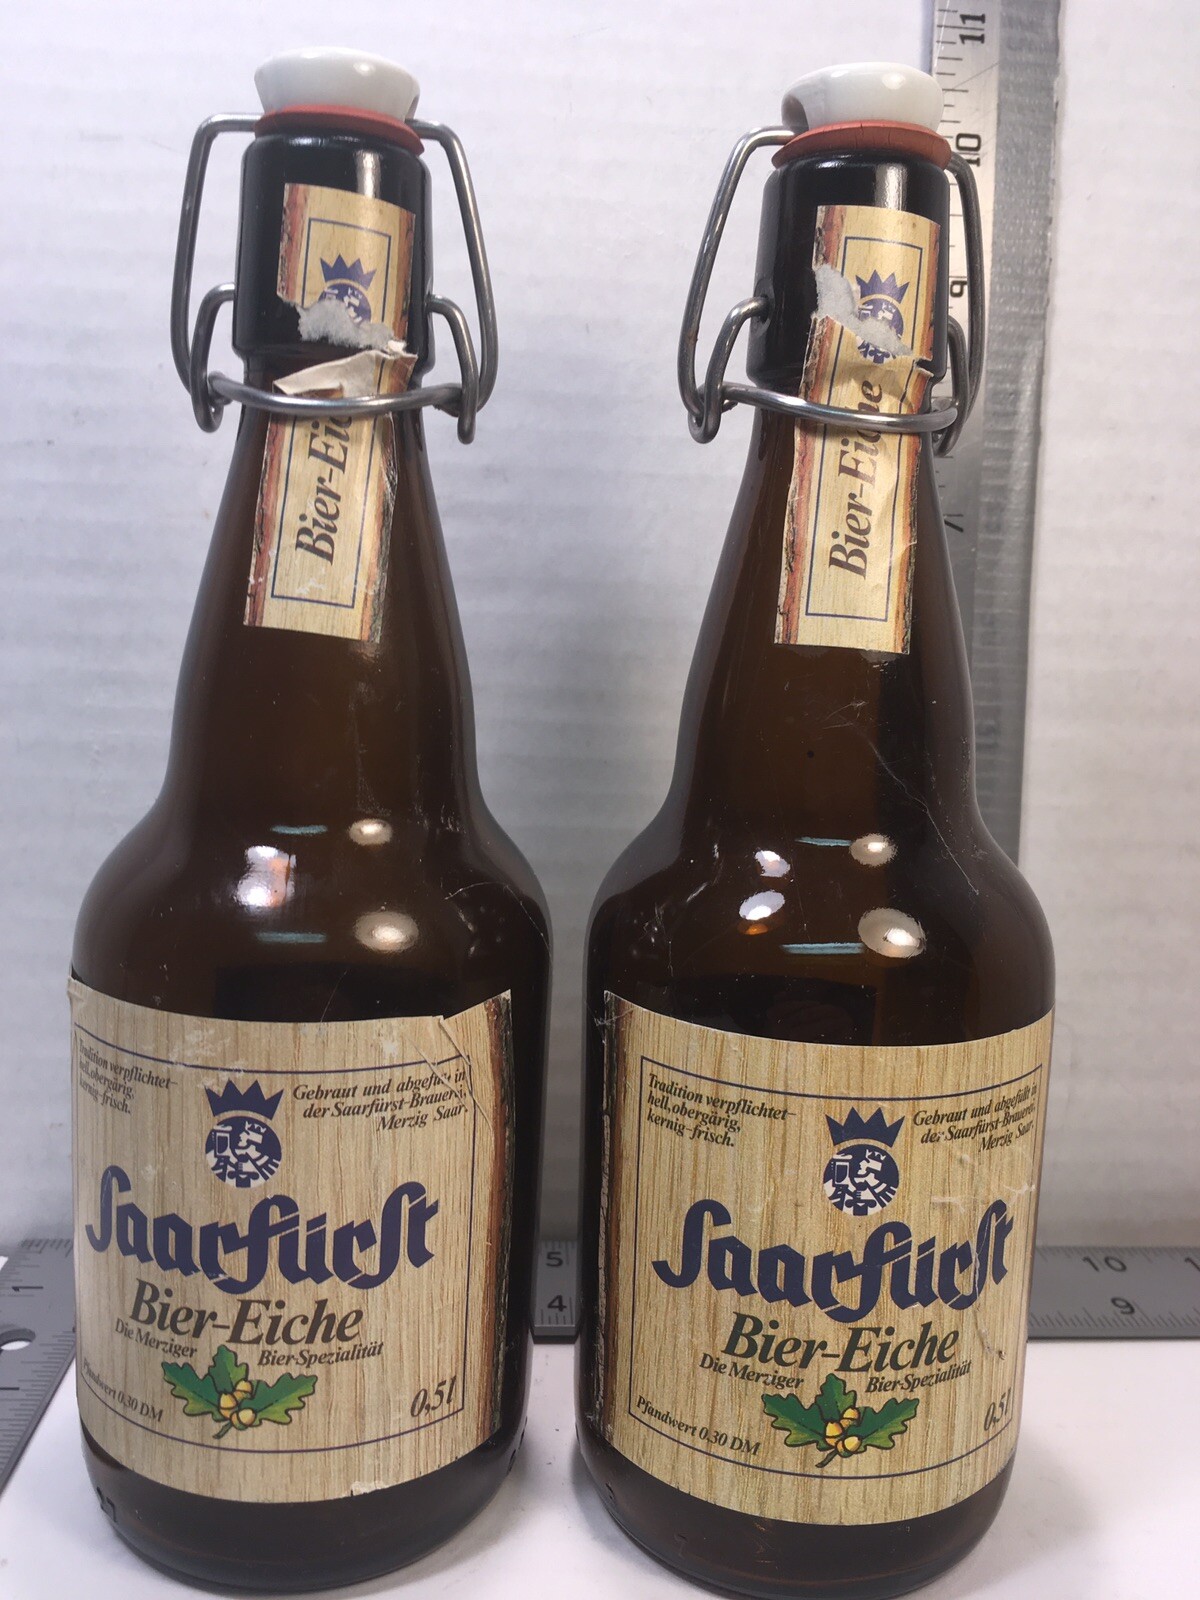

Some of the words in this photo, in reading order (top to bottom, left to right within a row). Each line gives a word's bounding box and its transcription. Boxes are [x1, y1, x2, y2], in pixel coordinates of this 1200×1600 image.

[959, 12, 985, 44] 11
[293, 1084, 358, 1100] Gebraut
[363, 1079, 393, 1096] und
[649, 1072, 703, 1104] Tradition
[303, 1103, 330, 1118] der
[376, 1111, 428, 1131] Merzig
[433, 1103, 468, 1121] Saar.
[913, 1107, 968, 1126] Gebraut
[970, 1098, 993, 1119] und
[978, 1129, 1013, 1152] Merzig
[85, 1164, 439, 1295] Saarfürst
[545, 1250, 564, 1268] 5
[651, 1198, 1014, 1323] Saarfürst
[1082, 1255, 1127, 1273] 10
[130, 1277, 364, 1346] Bier-Eiche
[547, 1294, 567, 1312] 4
[1111, 1297, 1136, 1316] 9
[115, 1317, 134, 1340] Die
[135, 1328, 198, 1358] Merziger
[721, 1310, 960, 1373] Bier-Eiche
[257, 1341, 384, 1368] Bier-Spezialität
[698, 1352, 728, 1377] Die
[729, 1359, 805, 1391] Merziger
[865, 1359, 972, 1393] Bier-Spezialität
[140, 1402, 164, 1422] DM
[636, 1395, 698, 1437] Pfandwert
[699, 1426, 729, 1449] 0,30
[729, 1433, 761, 1456] DM
